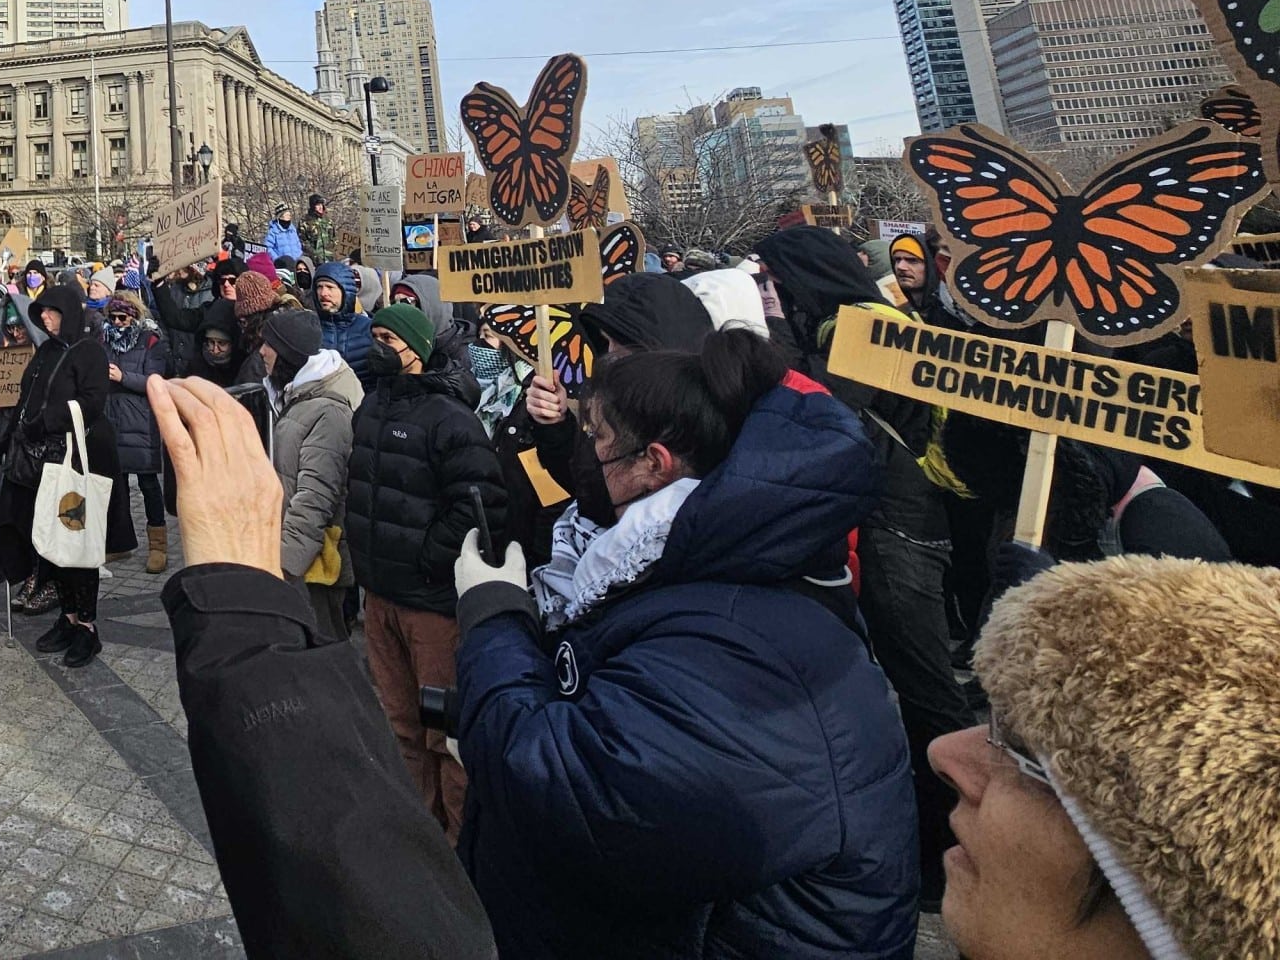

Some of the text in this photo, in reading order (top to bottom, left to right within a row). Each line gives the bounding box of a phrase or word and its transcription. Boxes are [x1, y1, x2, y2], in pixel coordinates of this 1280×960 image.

[412, 157, 464, 178] CHINGA
[157, 190, 209, 235] NO MORE
[379, 191, 391, 201] ARE
[414, 189, 462, 204] MIGRA
[449, 233, 584, 272] IMMIGRANTS GROW
[472, 262, 573, 295] COMMUNITIES
[1208, 302, 1280, 364] IM
[0, 370, 12, 380] IS
[870, 318, 1120, 398] IMMIGRANTS
[912, 360, 1191, 451] COMMUNITIES
